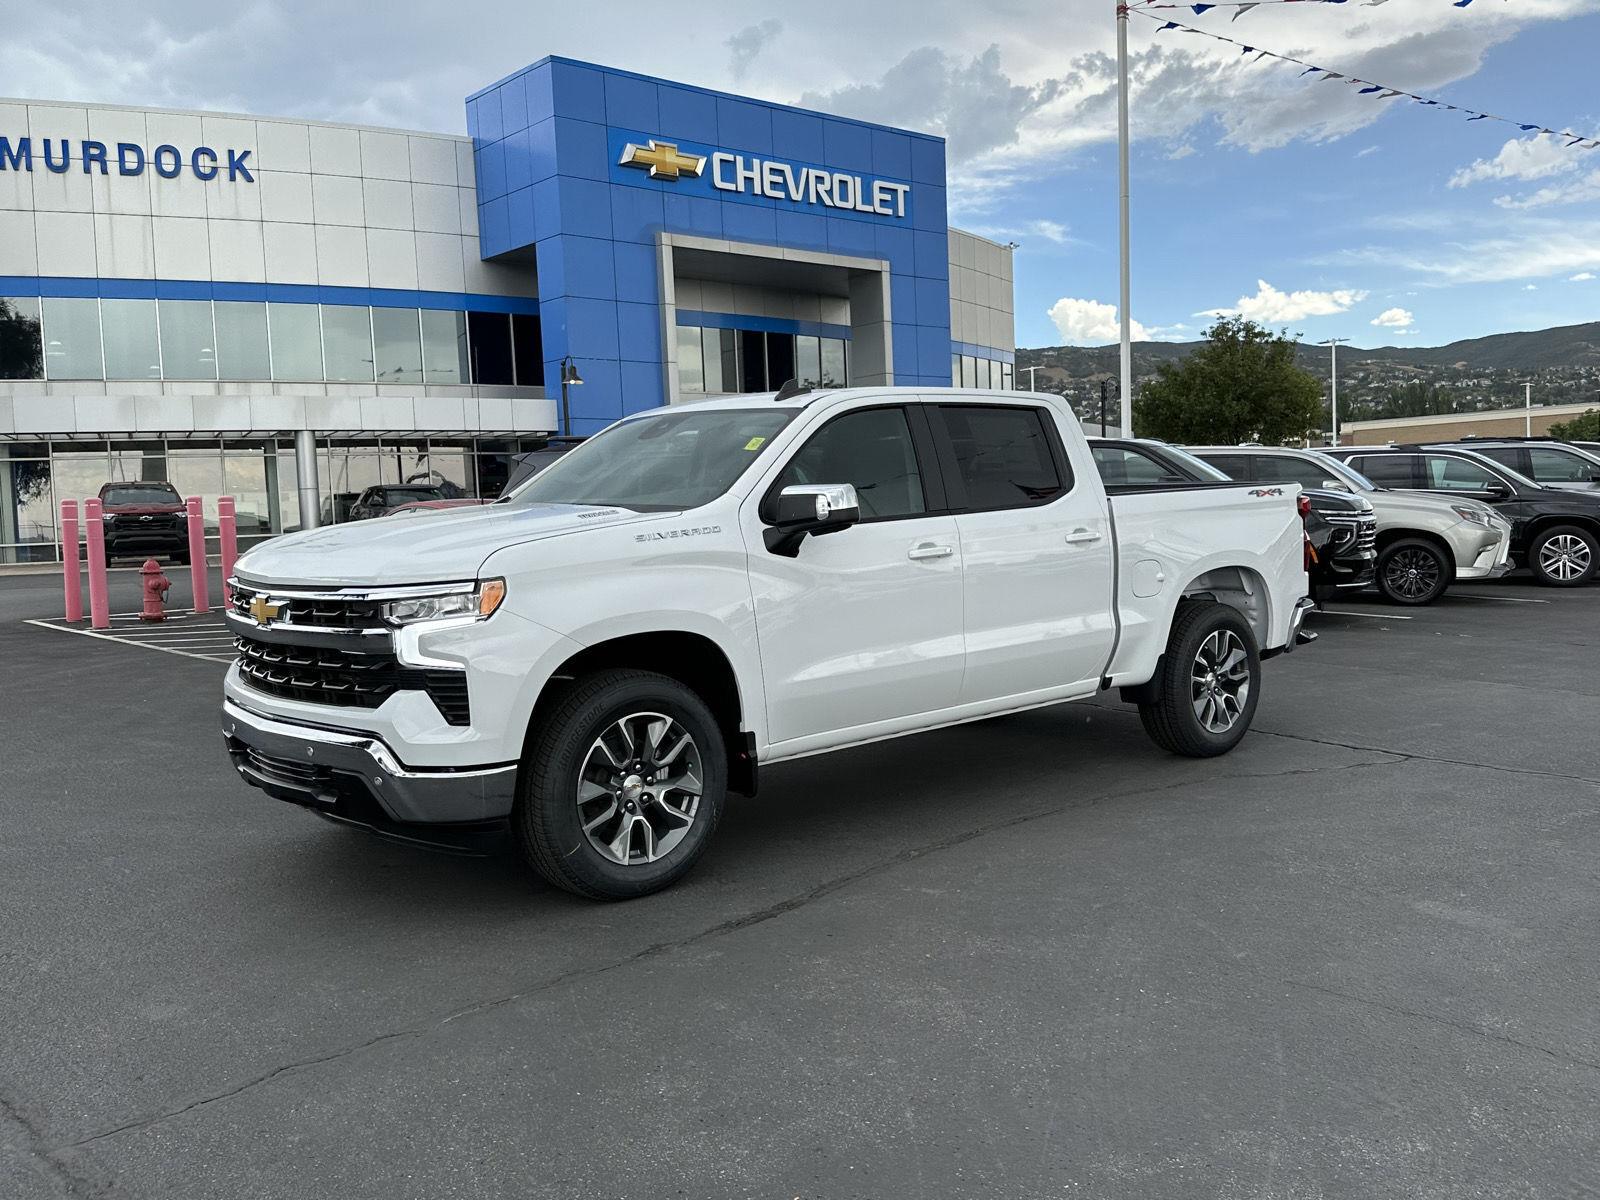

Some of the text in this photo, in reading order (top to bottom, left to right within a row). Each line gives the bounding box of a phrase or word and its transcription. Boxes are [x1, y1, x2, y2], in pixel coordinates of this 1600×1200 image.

[0, 136, 255, 183] MURDOCK
[712, 151, 910, 217] CHEVROLET
[634, 525, 721, 543] SILVERADO
